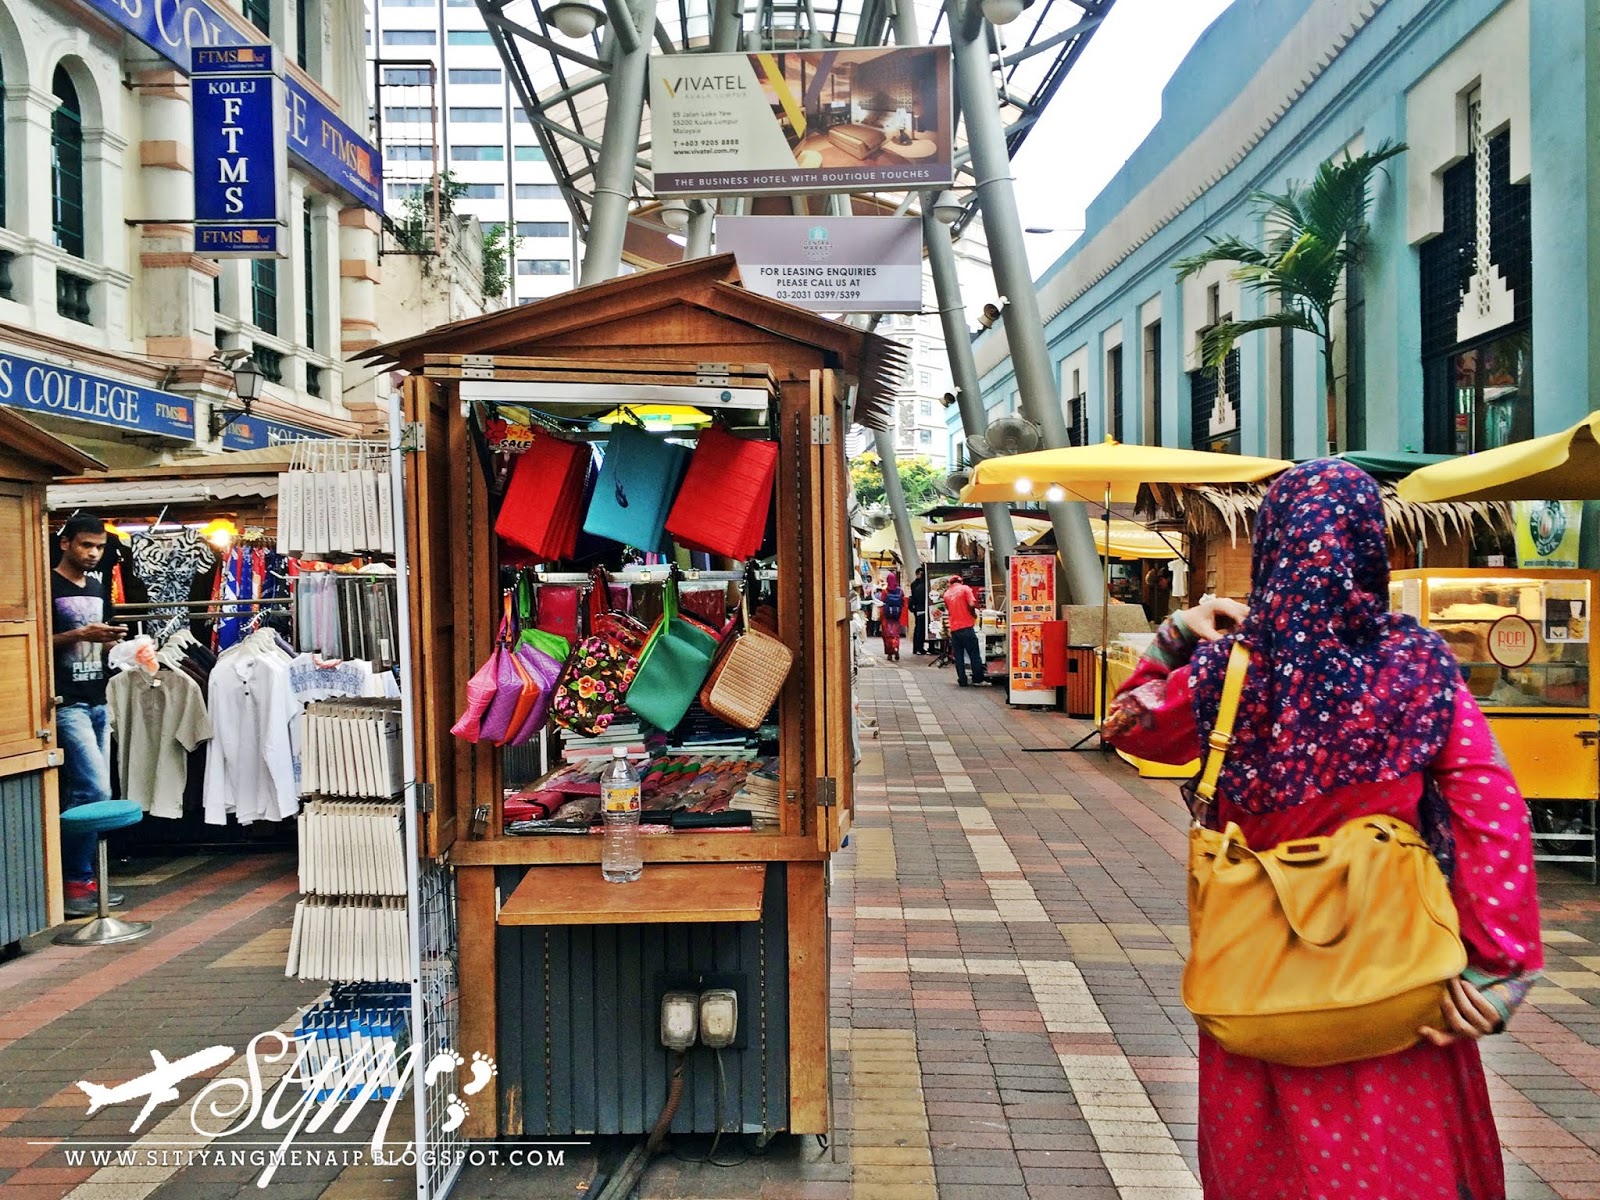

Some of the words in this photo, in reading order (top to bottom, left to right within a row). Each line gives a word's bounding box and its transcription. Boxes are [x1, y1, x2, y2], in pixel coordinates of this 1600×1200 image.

[198, 51, 238, 64] FTMS
[208, 81, 256, 95] KOLEJ
[663, 76, 746, 98] VIVATEL
[321, 118, 357, 171] FTMS
[673, 147, 739, 155] www.vivatel.com.my
[674, 178, 695, 187] THE
[698, 176, 749, 186] BUSINESS
[753, 175, 787, 185] HOTEL
[791, 174, 818, 183] WITH
[822, 171, 877, 182] BOUTIQUE
[880, 169, 930, 180] TOUCHES
[202, 230, 242, 244] FTMS
[760, 267, 780, 276] FOR
[782, 267, 824, 276] LEASING
[826, 267, 877, 276] ENQUIRIES
[776, 278, 808, 287] PLEASE
[810, 278, 834, 287] CALL
[835, 278, 847, 287] US
[849, 278, 861, 287] AT
[776, 290, 812, 299] 03-2031
[814, 290, 861, 299] 0399/5399
[24, 366, 140, 424] COLLEGE
[155, 402, 178, 420] FTMS
[501, 439, 531, 449] SALE
